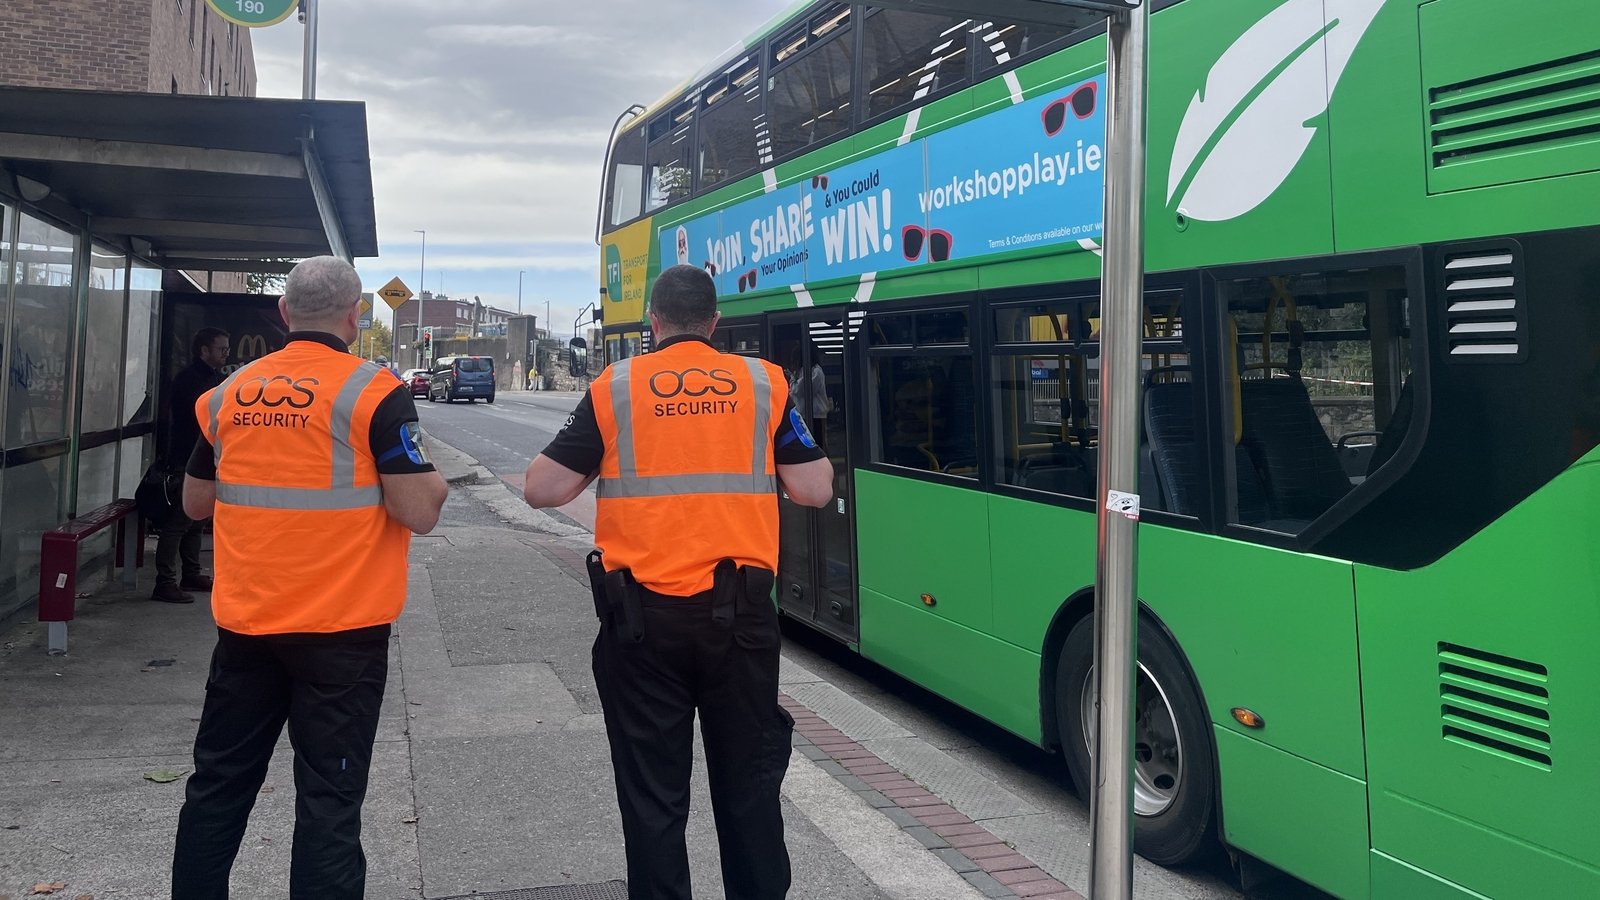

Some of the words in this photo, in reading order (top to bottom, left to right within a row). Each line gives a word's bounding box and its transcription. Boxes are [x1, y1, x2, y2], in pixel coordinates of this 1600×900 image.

[235, 0, 265, 14] 190
[824, 193, 833, 208] &
[832, 184, 851, 202] You
[851, 168, 880, 197] Could
[918, 139, 1102, 214] workshopplay.ie
[706, 231, 746, 276] JOIN,
[750, 193, 813, 263] SHARE
[820, 187, 893, 266] WIN!
[988, 237, 1006, 249] Terms
[1005, 236, 1011, 245] &
[1011, 232, 1043, 246] Conditions
[1043, 227, 1071, 240] available
[1071, 225, 1082, 235] on
[1081, 223, 1094, 233] our
[607, 262, 620, 284] TFI
[622, 254, 648, 269] TRANSPORT
[760, 259, 778, 277] Your
[777, 248, 809, 270] Opinions
[623, 274, 632, 286] FOR
[624, 288, 642, 301] IRELAND
[235, 375, 320, 408] OCS
[649, 367, 738, 398] OCS
[232, 412, 310, 429] SECURITY
[654, 400, 738, 417] SECURITY
